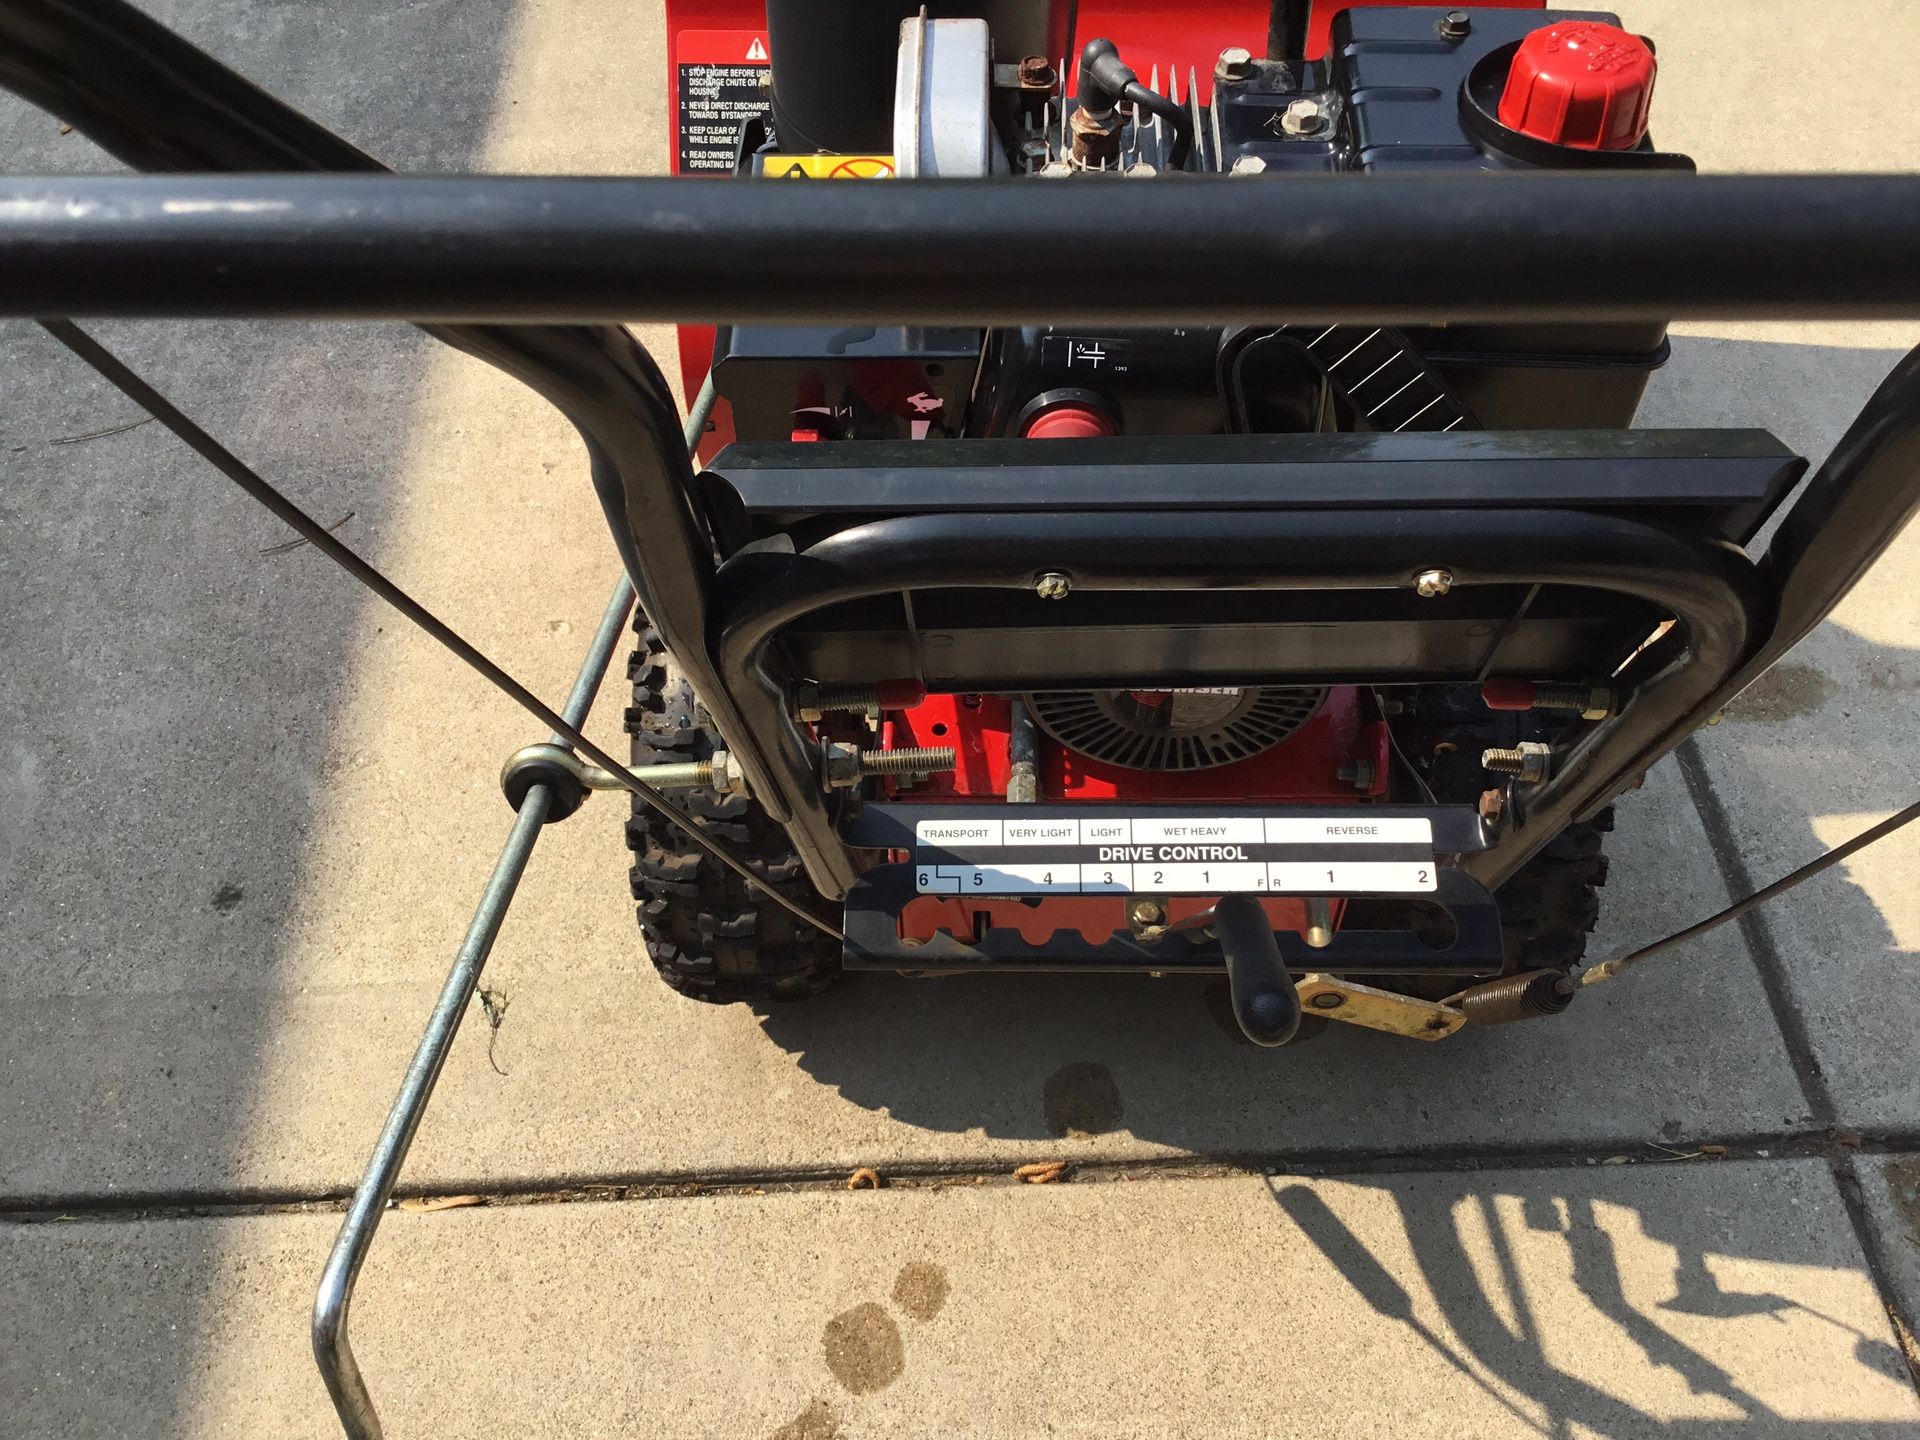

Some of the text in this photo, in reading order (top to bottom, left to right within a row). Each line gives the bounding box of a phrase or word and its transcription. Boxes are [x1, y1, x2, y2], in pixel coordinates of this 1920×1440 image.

[688, 68, 706, 77] STOP
[706, 68, 730, 77] ENGINE
[730, 68, 755, 77] BEFORE
[689, 78, 725, 87] DISCHARGE
[725, 78, 747, 87] CHUTE
[747, 78, 757, 87] OR
[681, 101, 770, 111] 2. NEVER DIRECT DISCHARGE
[688, 110, 719, 119] TOWARDS
[681, 126, 687, 134] 3.
[689, 126, 706, 134] KEEP
[706, 126, 728, 134] CLEAR
[728, 126, 737, 135] OF
[688, 135, 709, 144] WHILE
[709, 136, 733, 144] ENGINE
[689, 150, 707, 159] READ
[707, 151, 734, 160] OWNERS
[689, 160, 725, 169] OPERATING
[923, 828, 990, 839] TRANSPORT
[1008, 828, 1073, 838] VERY LIGHT
[1090, 827, 1123, 837] LIGHT
[1163, 826, 1227, 836] WET HEAVY
[1326, 826, 1378, 835] REVERSE
[1099, 846, 1249, 861] DRIVE CONTROL
[918, 872, 929, 886] 6
[973, 872, 983, 886] 5
[1043, 871, 1053, 885] 4
[1103, 871, 1113, 885] 3
[1153, 871, 1163, 884] 2
[1202, 870, 1210, 883] 1
[1327, 870, 1335, 883] 1
[1418, 870, 1428, 883] 2
[1257, 878, 1264, 887] F
[1273, 878, 1281, 887] R
